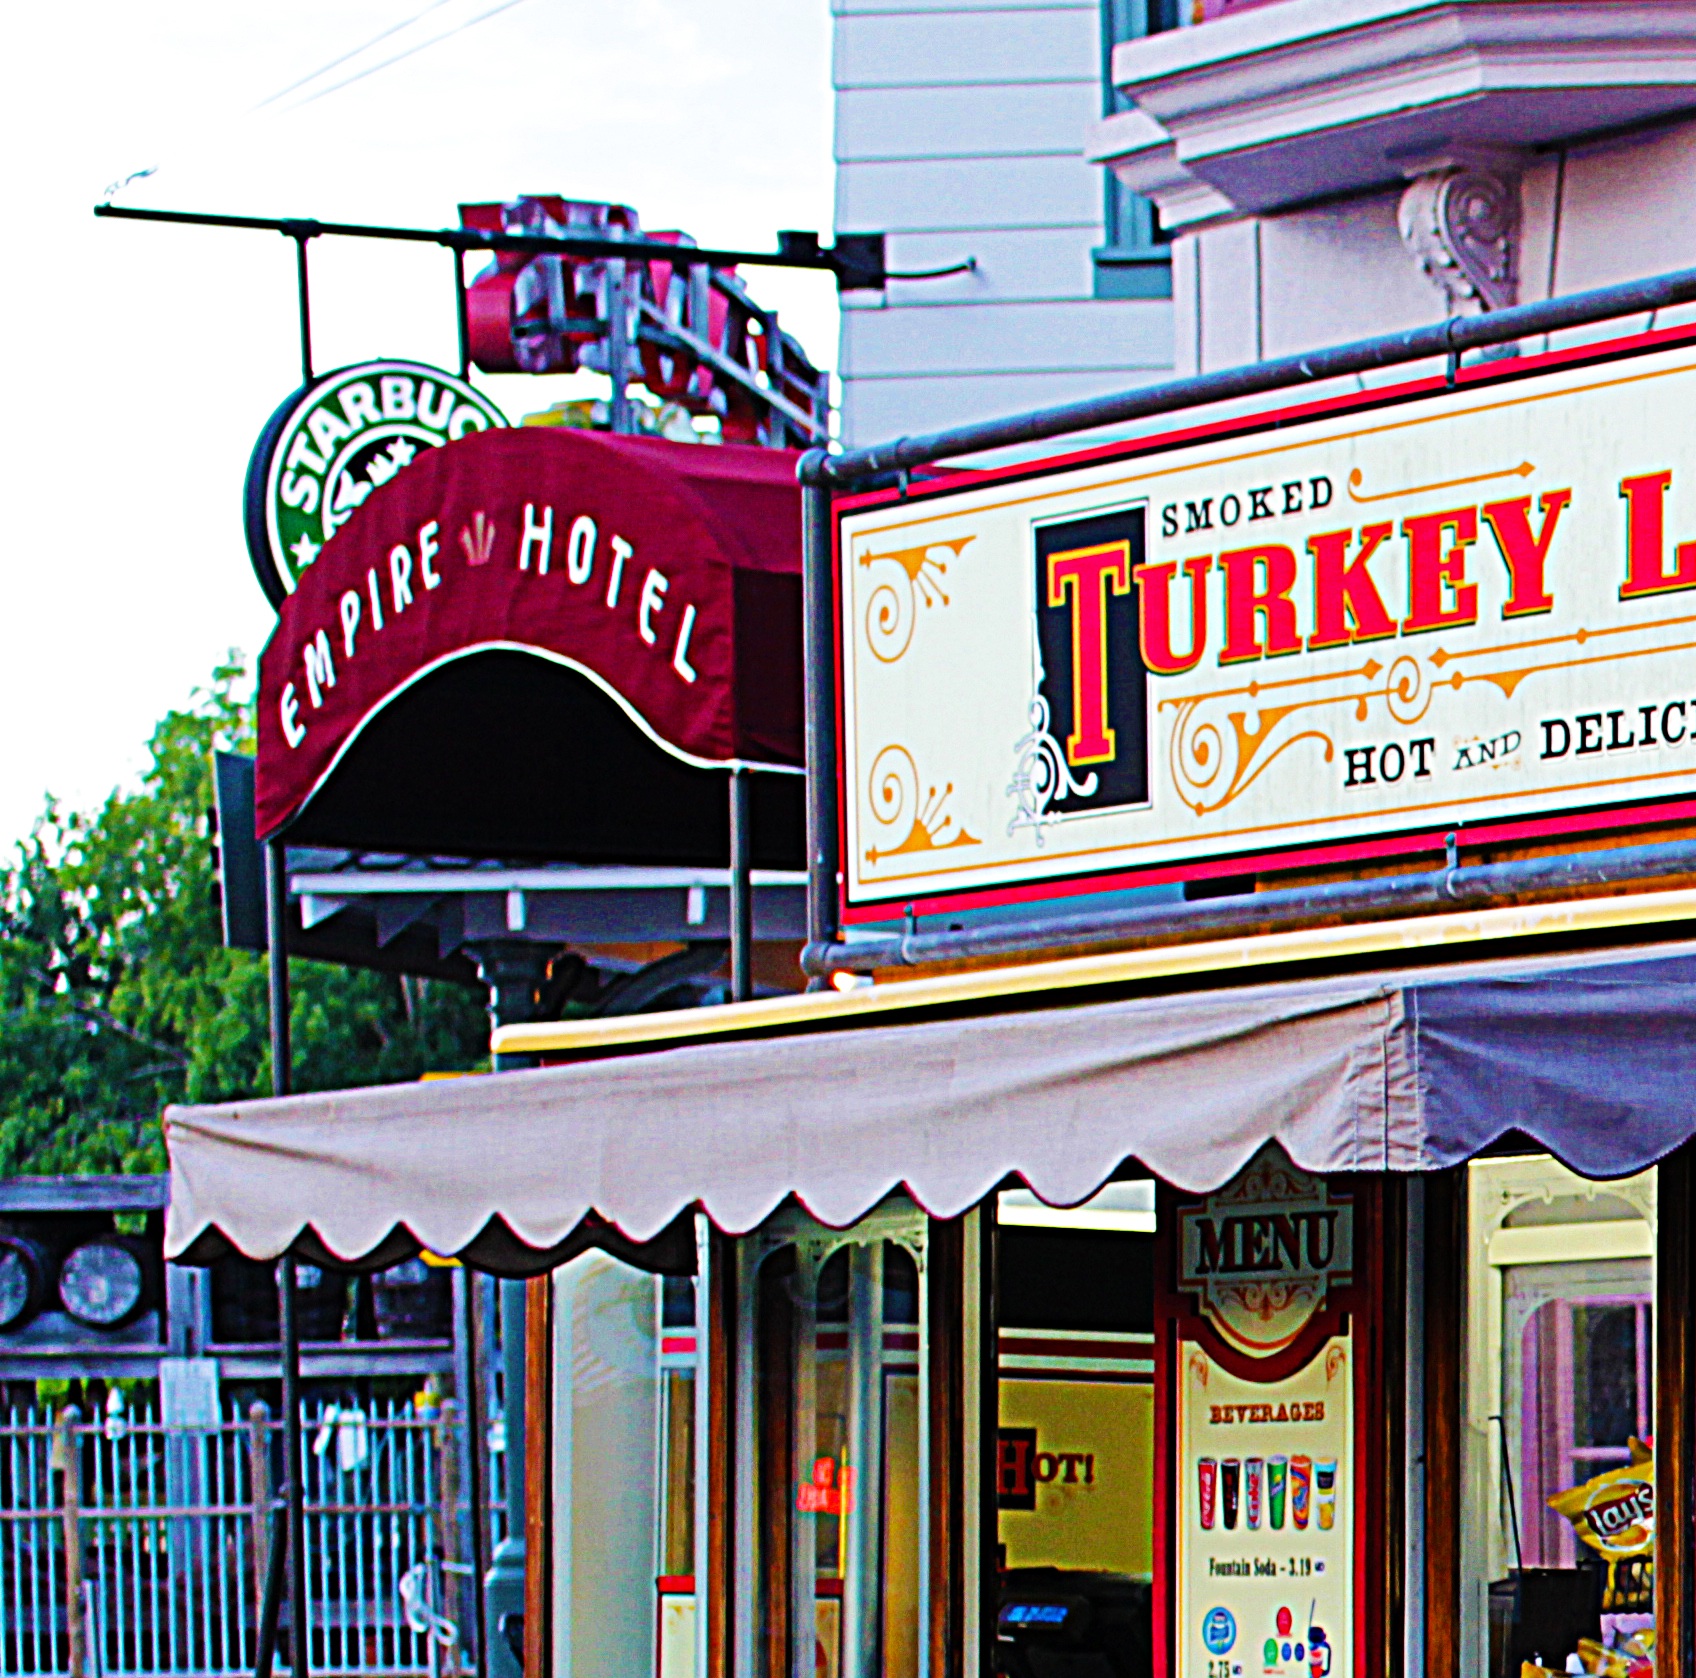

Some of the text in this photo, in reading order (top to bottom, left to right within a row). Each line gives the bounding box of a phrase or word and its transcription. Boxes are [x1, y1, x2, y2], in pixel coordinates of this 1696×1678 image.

[1162, 475, 1334, 538] SMOKED
[280, 503, 697, 749] EMPIRE HOTEL
[1047, 488, 1573, 767] TURKEY
[1343, 737, 1437, 790] HOT
[1452, 730, 1522, 770] AND
[1195, 1210, 1338, 1274] MENU
[1209, 1400, 1325, 1424] BEVERAGES
[997, 1440, 1095, 1495] HOT!
[1209, 1557, 1251, 1577] Fountain
[1254, 1557, 1276, 1577] Soda
